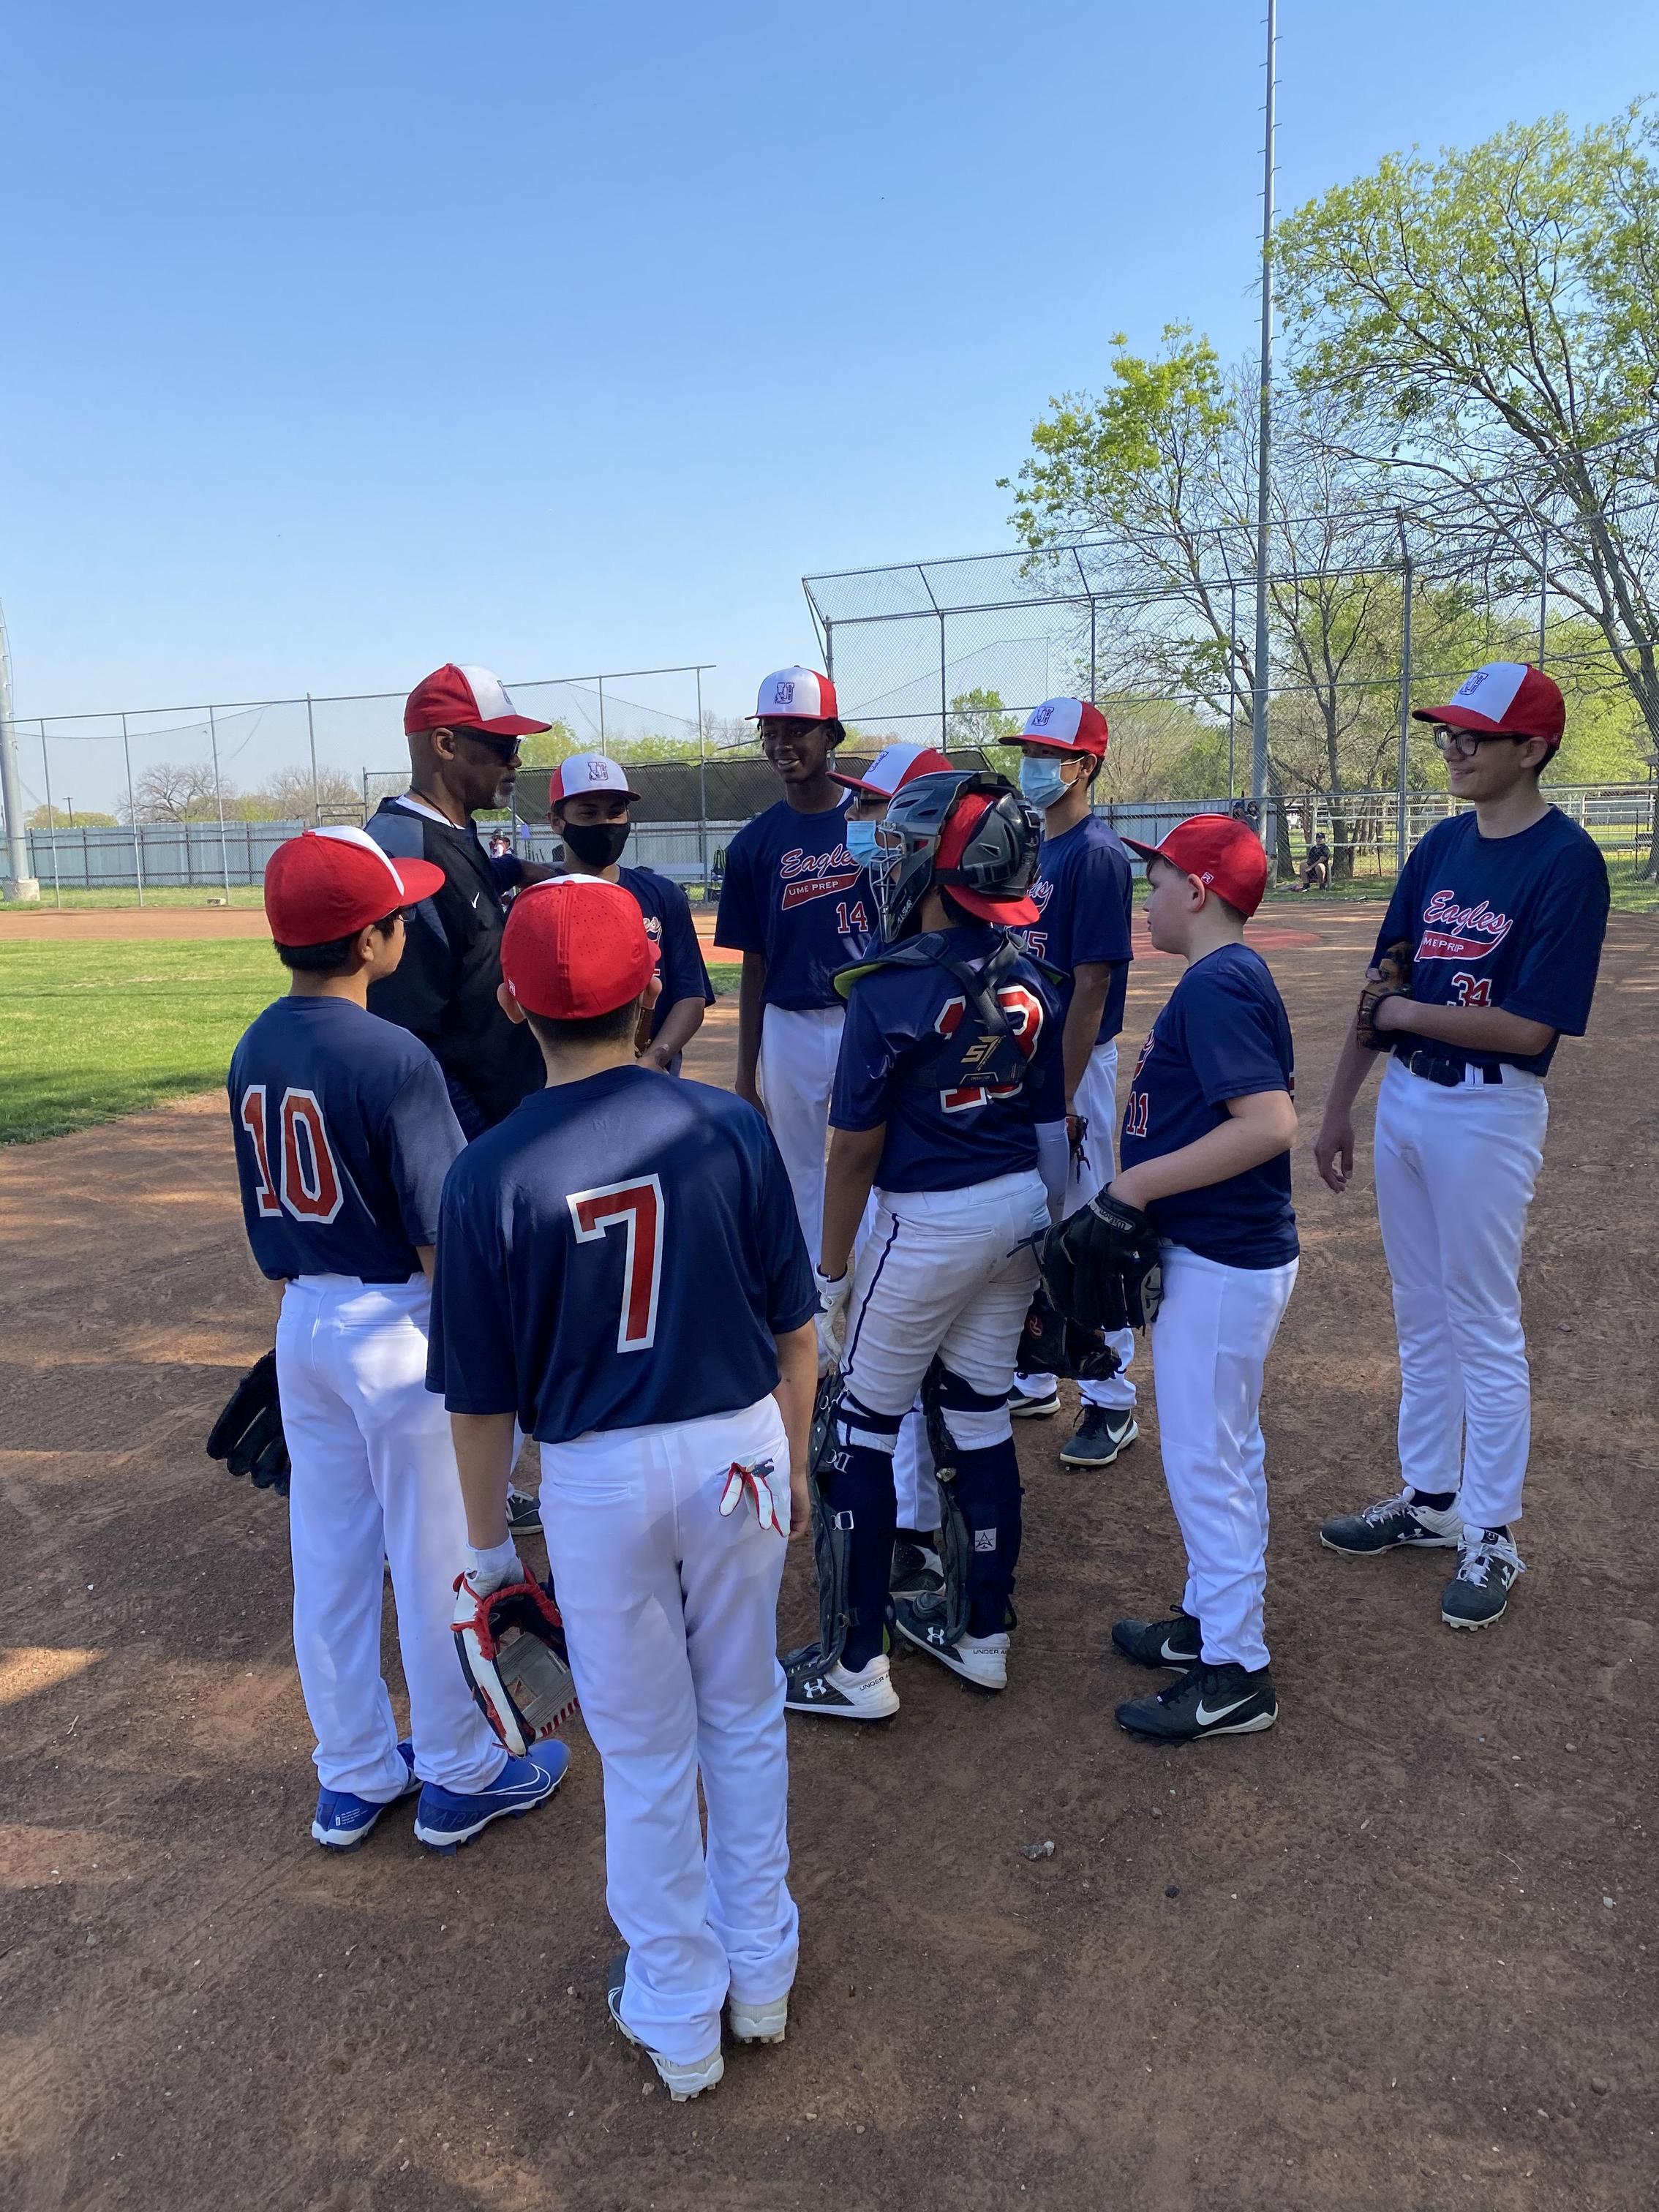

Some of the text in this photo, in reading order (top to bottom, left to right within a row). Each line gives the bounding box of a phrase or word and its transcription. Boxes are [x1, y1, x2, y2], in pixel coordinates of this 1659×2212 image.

[780, 843, 860, 879] Eagle
[789, 881, 839, 896] UME PREP
[836, 901, 869, 934] 14
[1423, 889, 1510, 936] Eagles
[1447, 971, 1493, 1008] 34
[1126, 1091, 1149, 1138] 11
[241, 1084, 344, 1224] 10
[1099, 1208, 1126, 1230] Wilson
[565, 1173, 665, 1353] 7
[859, 1676, 884, 1691] UNDER
